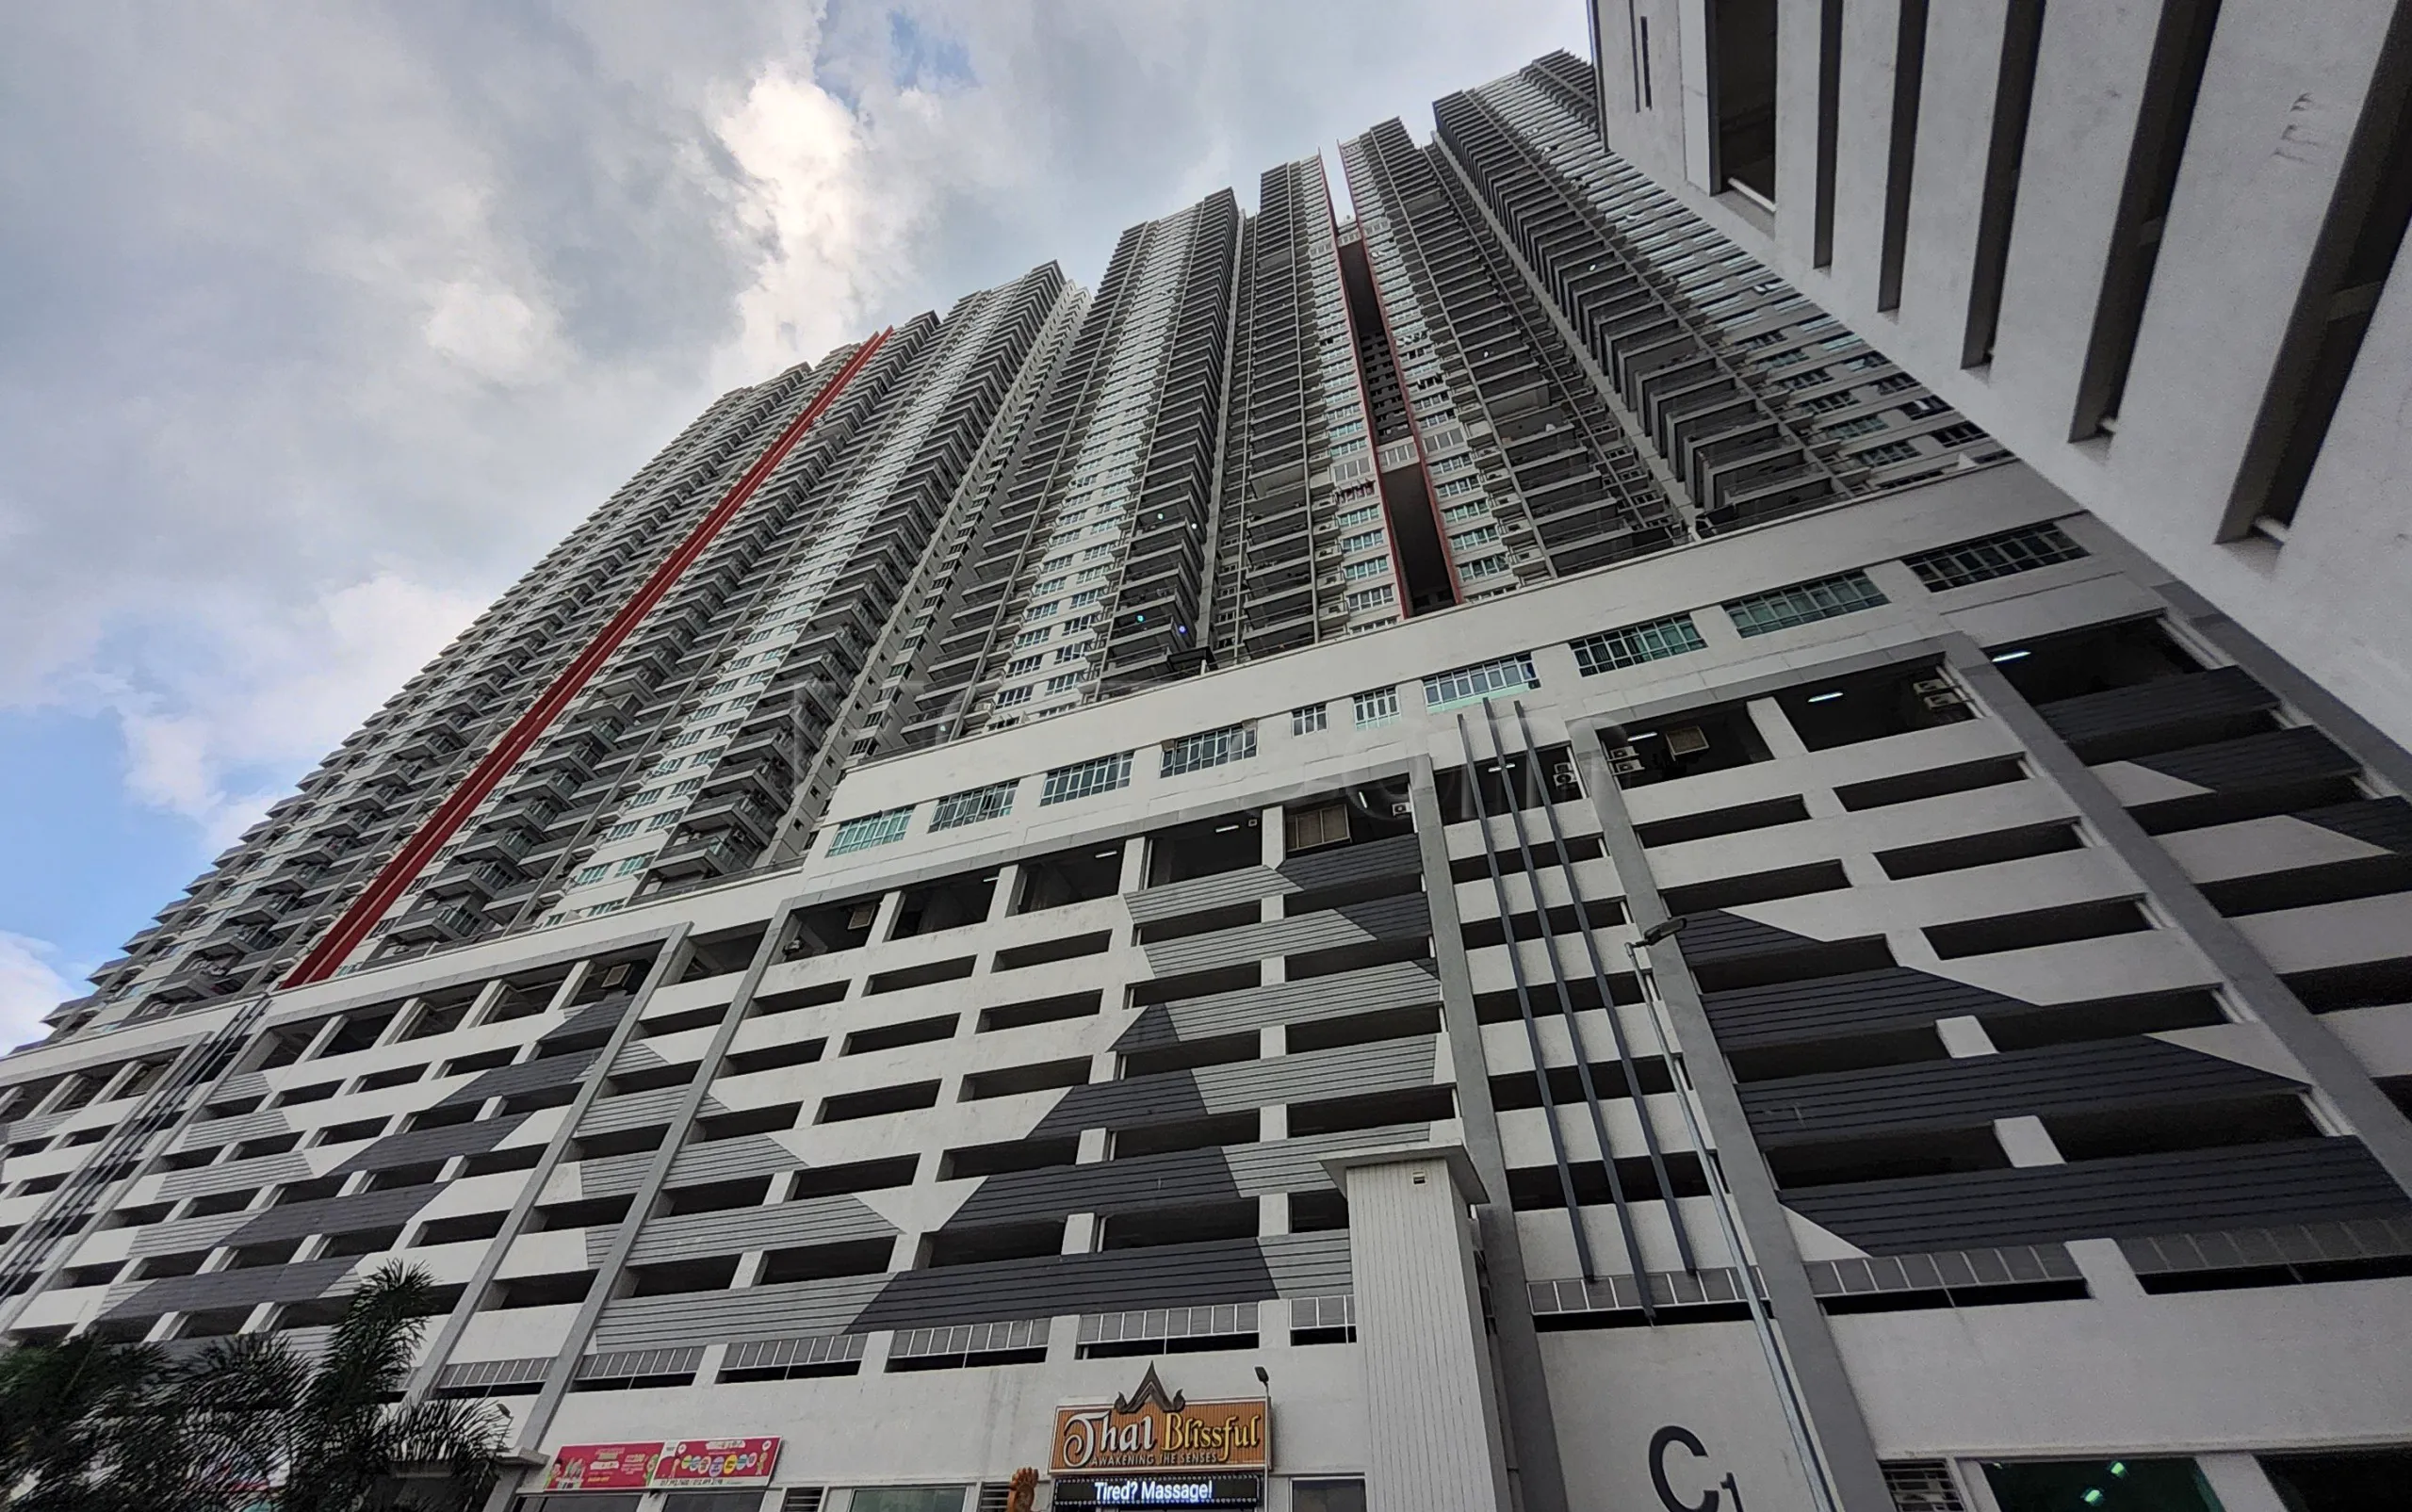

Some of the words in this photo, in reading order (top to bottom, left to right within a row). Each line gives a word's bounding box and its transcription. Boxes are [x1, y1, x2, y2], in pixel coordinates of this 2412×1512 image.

[1161, 1411, 1262, 1462] Blissful
[1091, 1454, 1154, 1467] AWAKENING
[1159, 1452, 1176, 1465] THE
[1180, 1452, 1218, 1464] SENSES
[1094, 1481, 1138, 1501] Tired?
[1141, 1480, 1213, 1503] Massage!
